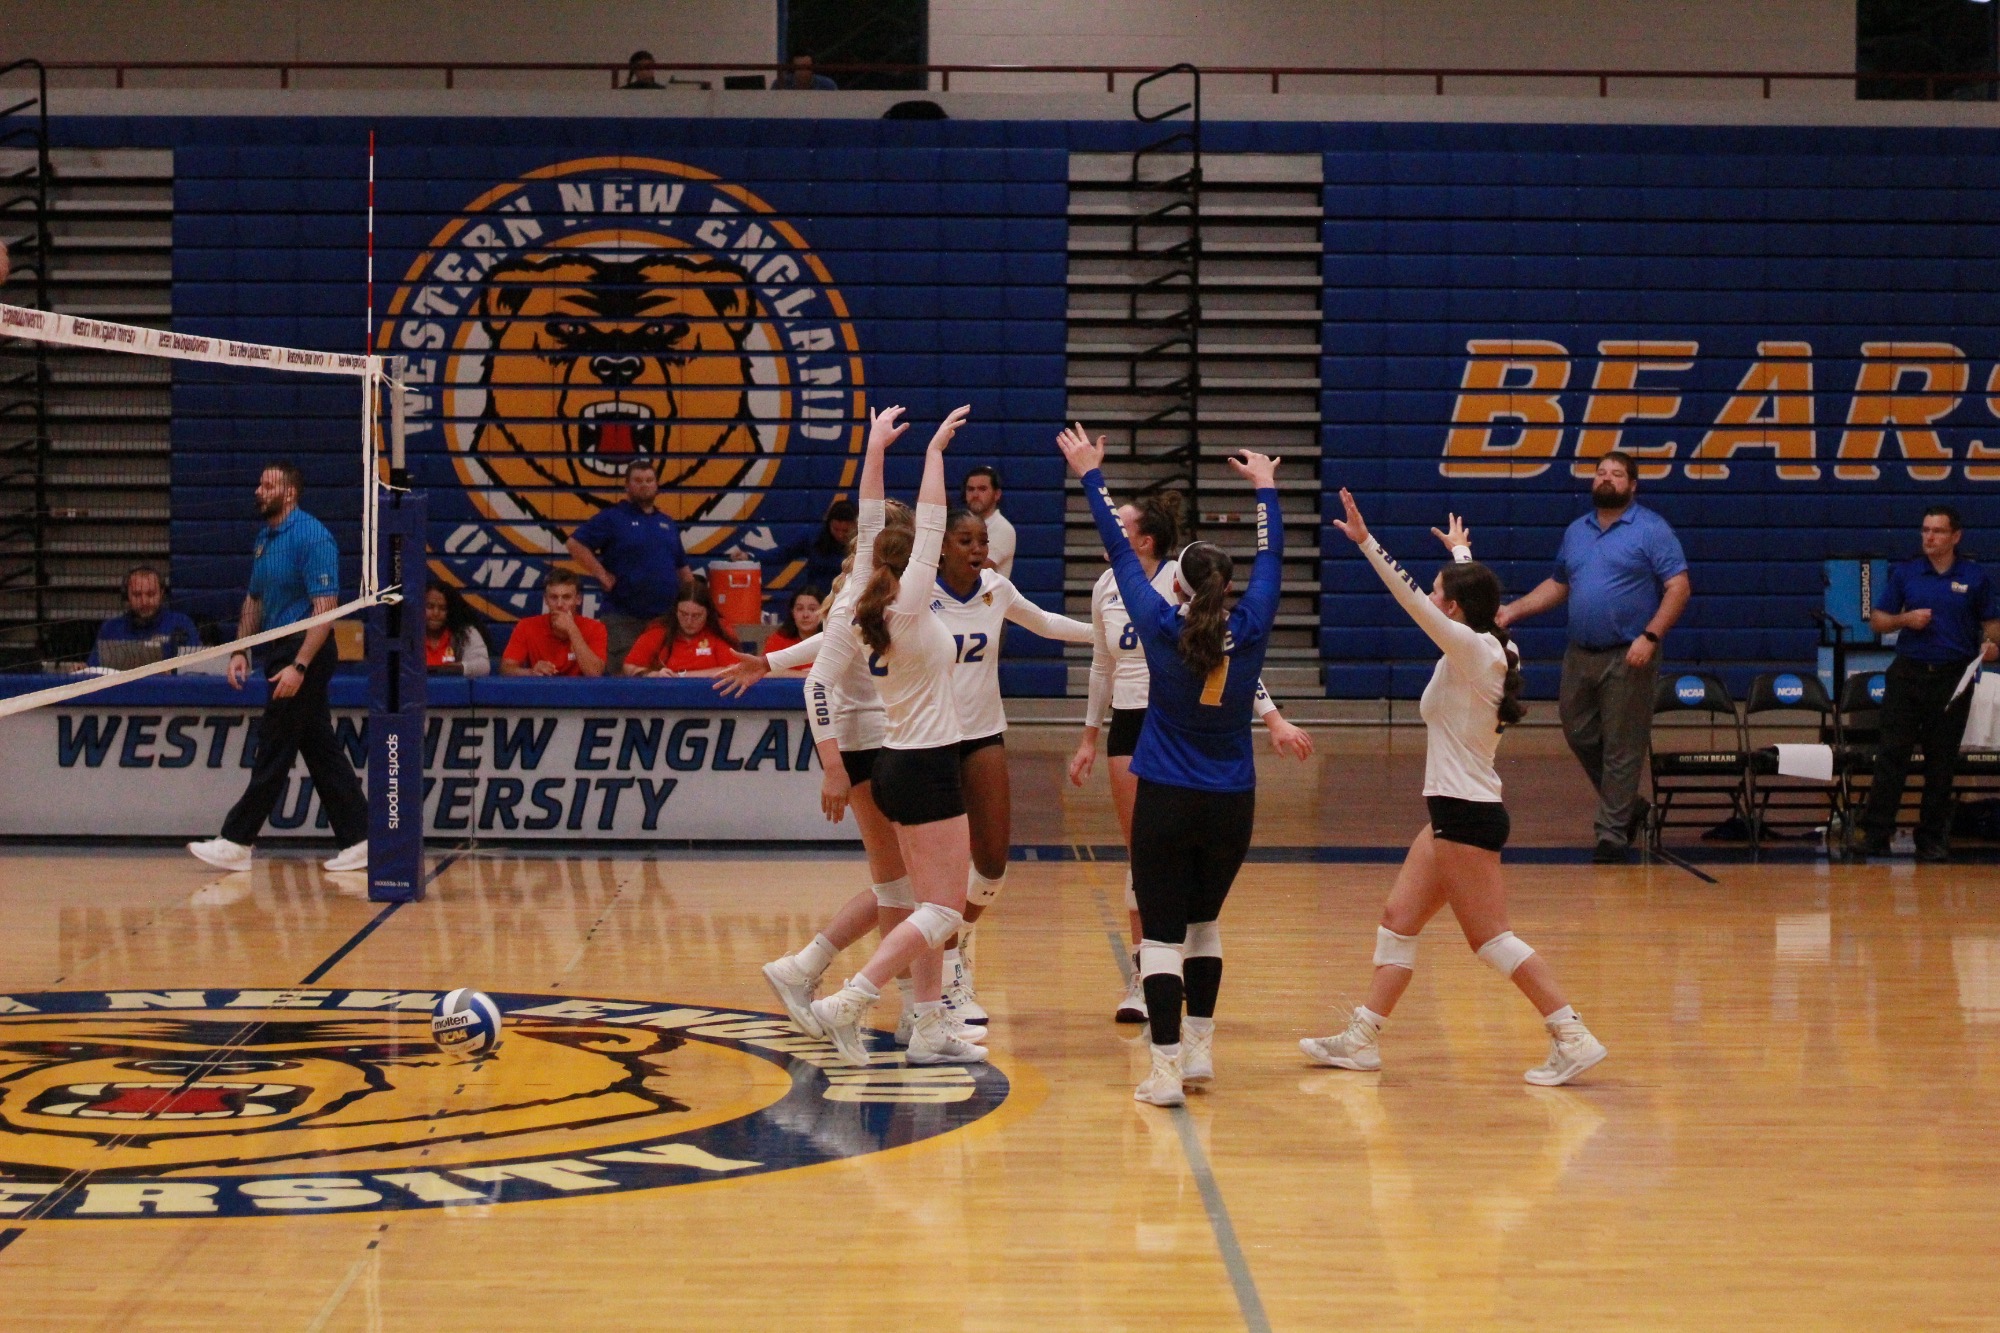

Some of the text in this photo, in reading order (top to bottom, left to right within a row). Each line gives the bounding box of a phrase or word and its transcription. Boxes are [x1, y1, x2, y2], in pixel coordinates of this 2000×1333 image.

[390, 183, 845, 441] WESTERN NEW ENGLAND
[1440, 339, 2000, 481] BEAR
[1861, 563, 1871, 619] POWERADE
[952, 632, 988, 664] 12
[1679, 688, 1705, 698] NCAA
[1777, 687, 1803, 697] NCAA
[56, 715, 368, 769] WESTN
[574, 717, 824, 771] ENGLA
[1679, 754, 1736, 763] GOLDEN BEARS
[268, 776, 678, 831] UERSITY
[386, 733, 400, 829] sports imports
[434, 1015, 469, 1030] molten
